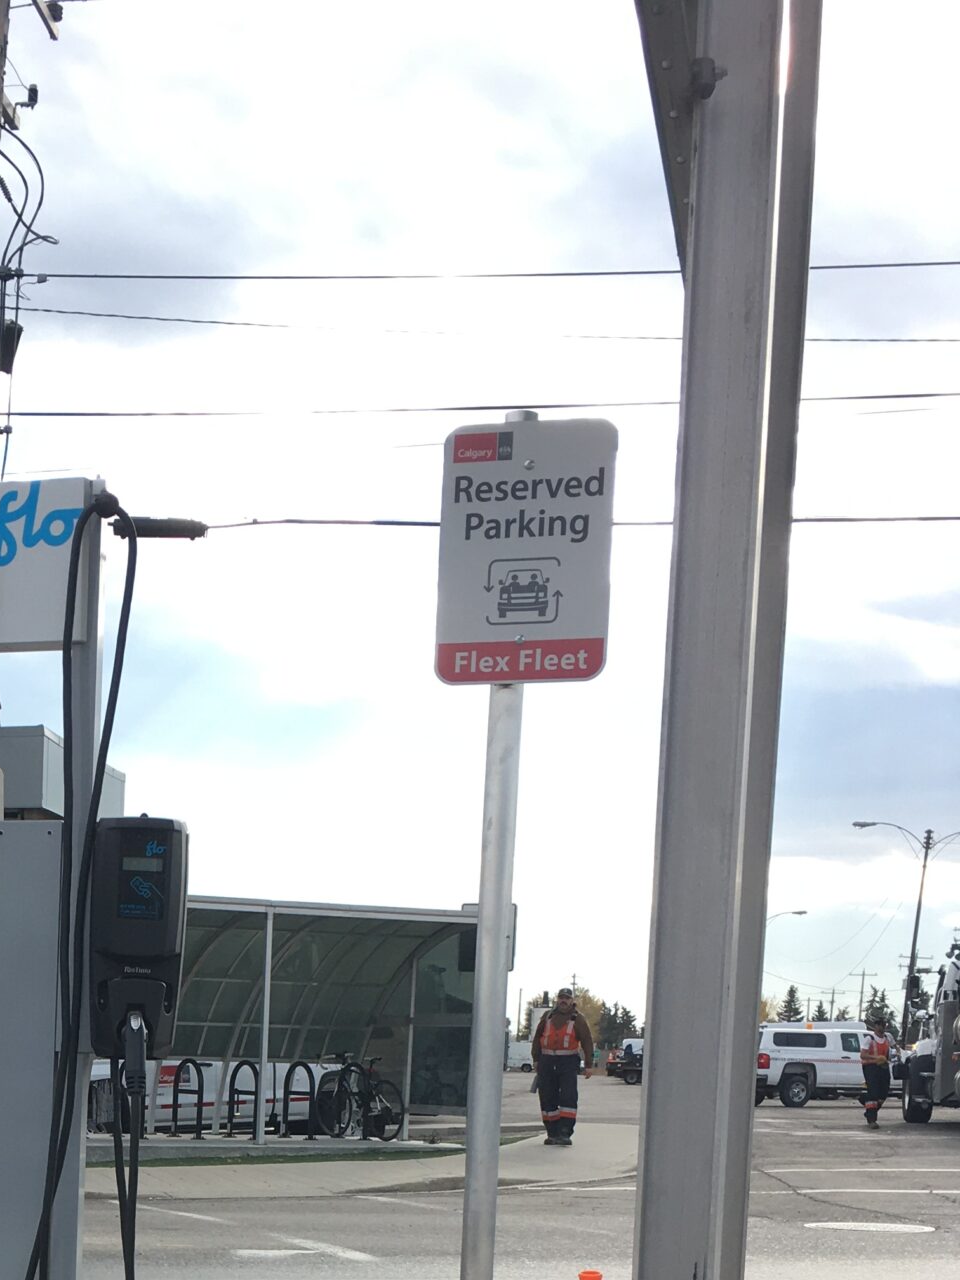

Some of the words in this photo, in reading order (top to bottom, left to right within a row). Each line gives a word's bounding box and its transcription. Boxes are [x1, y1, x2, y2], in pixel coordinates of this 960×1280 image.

[457, 448, 493, 460] Calgary
[454, 467, 605, 504] Reserved
[464, 509, 590, 543] Parking
[454, 651, 510, 673] Flex
[518, 648, 588, 671] Fleet
[145, 840, 167, 857] flo
